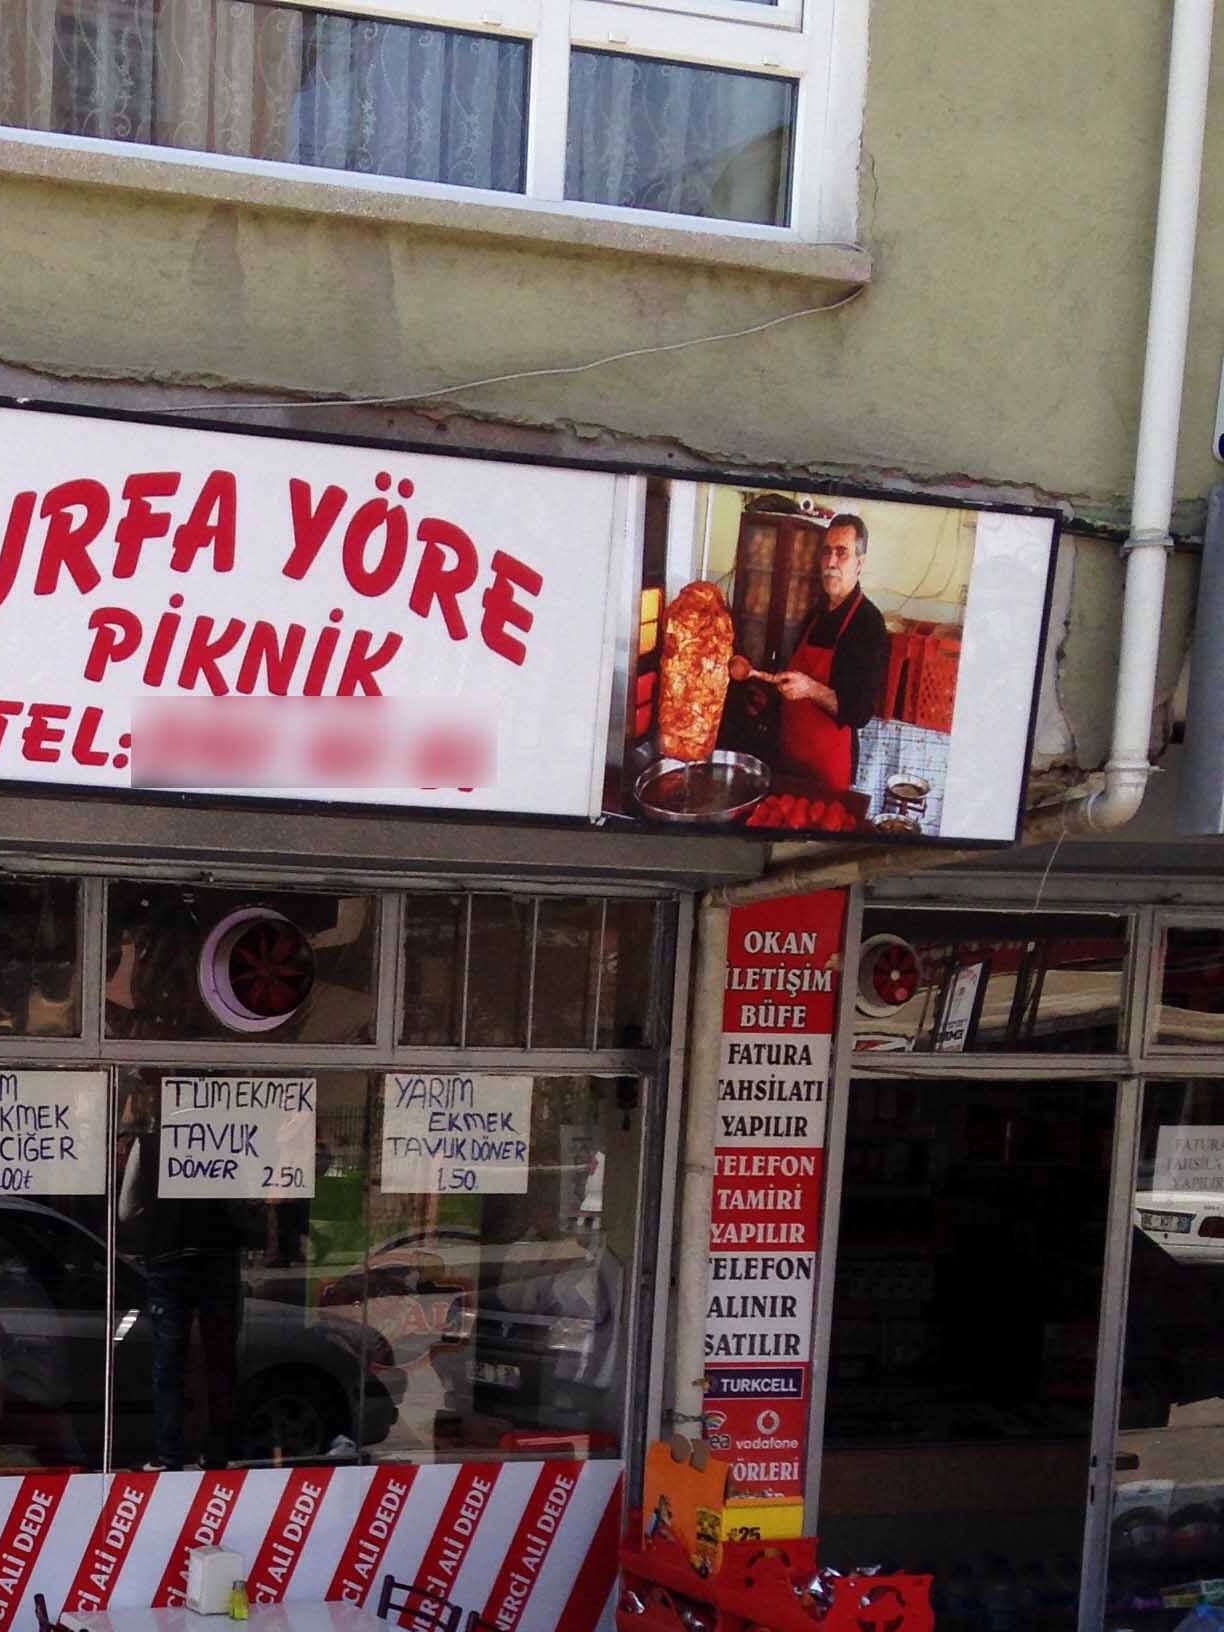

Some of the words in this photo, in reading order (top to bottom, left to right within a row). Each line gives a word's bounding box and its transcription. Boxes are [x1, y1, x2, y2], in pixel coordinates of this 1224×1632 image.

[281, 470, 545, 667] YÖRE
[83, 593, 404, 698] PİKNİK
[743, 930, 818, 955] OKAN
[725, 961, 833, 997] İLETİŞİM
[740, 999, 807, 1028] BÜFE
[728, 1043, 813, 1066] FATURA
[165, 1077, 231, 1111] TÜM
[236, 1080, 314, 1112] EKMEK
[394, 1077, 474, 1109] YARIM
[428, 1111, 520, 1134] EKMEK
[721, 1115, 808, 1137] YAPILIR
[0, 1132, 78, 1162] CİĞER
[162, 1123, 259, 1157] TAVUK
[386, 1136, 466, 1161] TAVUK
[471, 1135, 527, 1162] DÖNER
[168, 1155, 239, 1180] DÖNER
[713, 1155, 816, 1177] TELEFON
[717, 1183, 804, 1211] TAMİRİ
[710, 1223, 806, 1244] YAPILIR
[708, 1257, 813, 1281] ELEFON
[706, 1295, 798, 1318] ALINIR
[704, 1333, 801, 1356] SATILIR
[720, 1377, 798, 1393] TURKCELL
[735, 1436, 800, 1450] vodafone
[729, 1456, 800, 1483] ÖRLERİ
[12, 1488, 54, 1553] DEDE
[194, 1483, 234, 1546] DEDE
[437, 1536, 465, 1577] ALİ
[452, 1476, 492, 1536] DEDE
[521, 1533, 548, 1573] ALİ
[536, 1474, 576, 1534] DEDE
[89, 1549, 118, 1592] ALİ
[105, 1486, 145, 1551] DEDE
[267, 1542, 295, 1584] ALİ
[282, 1481, 322, 1543] DEDE
[354, 1539, 381, 1579] ALİ
[368, 1479, 408, 1540] DEDE
